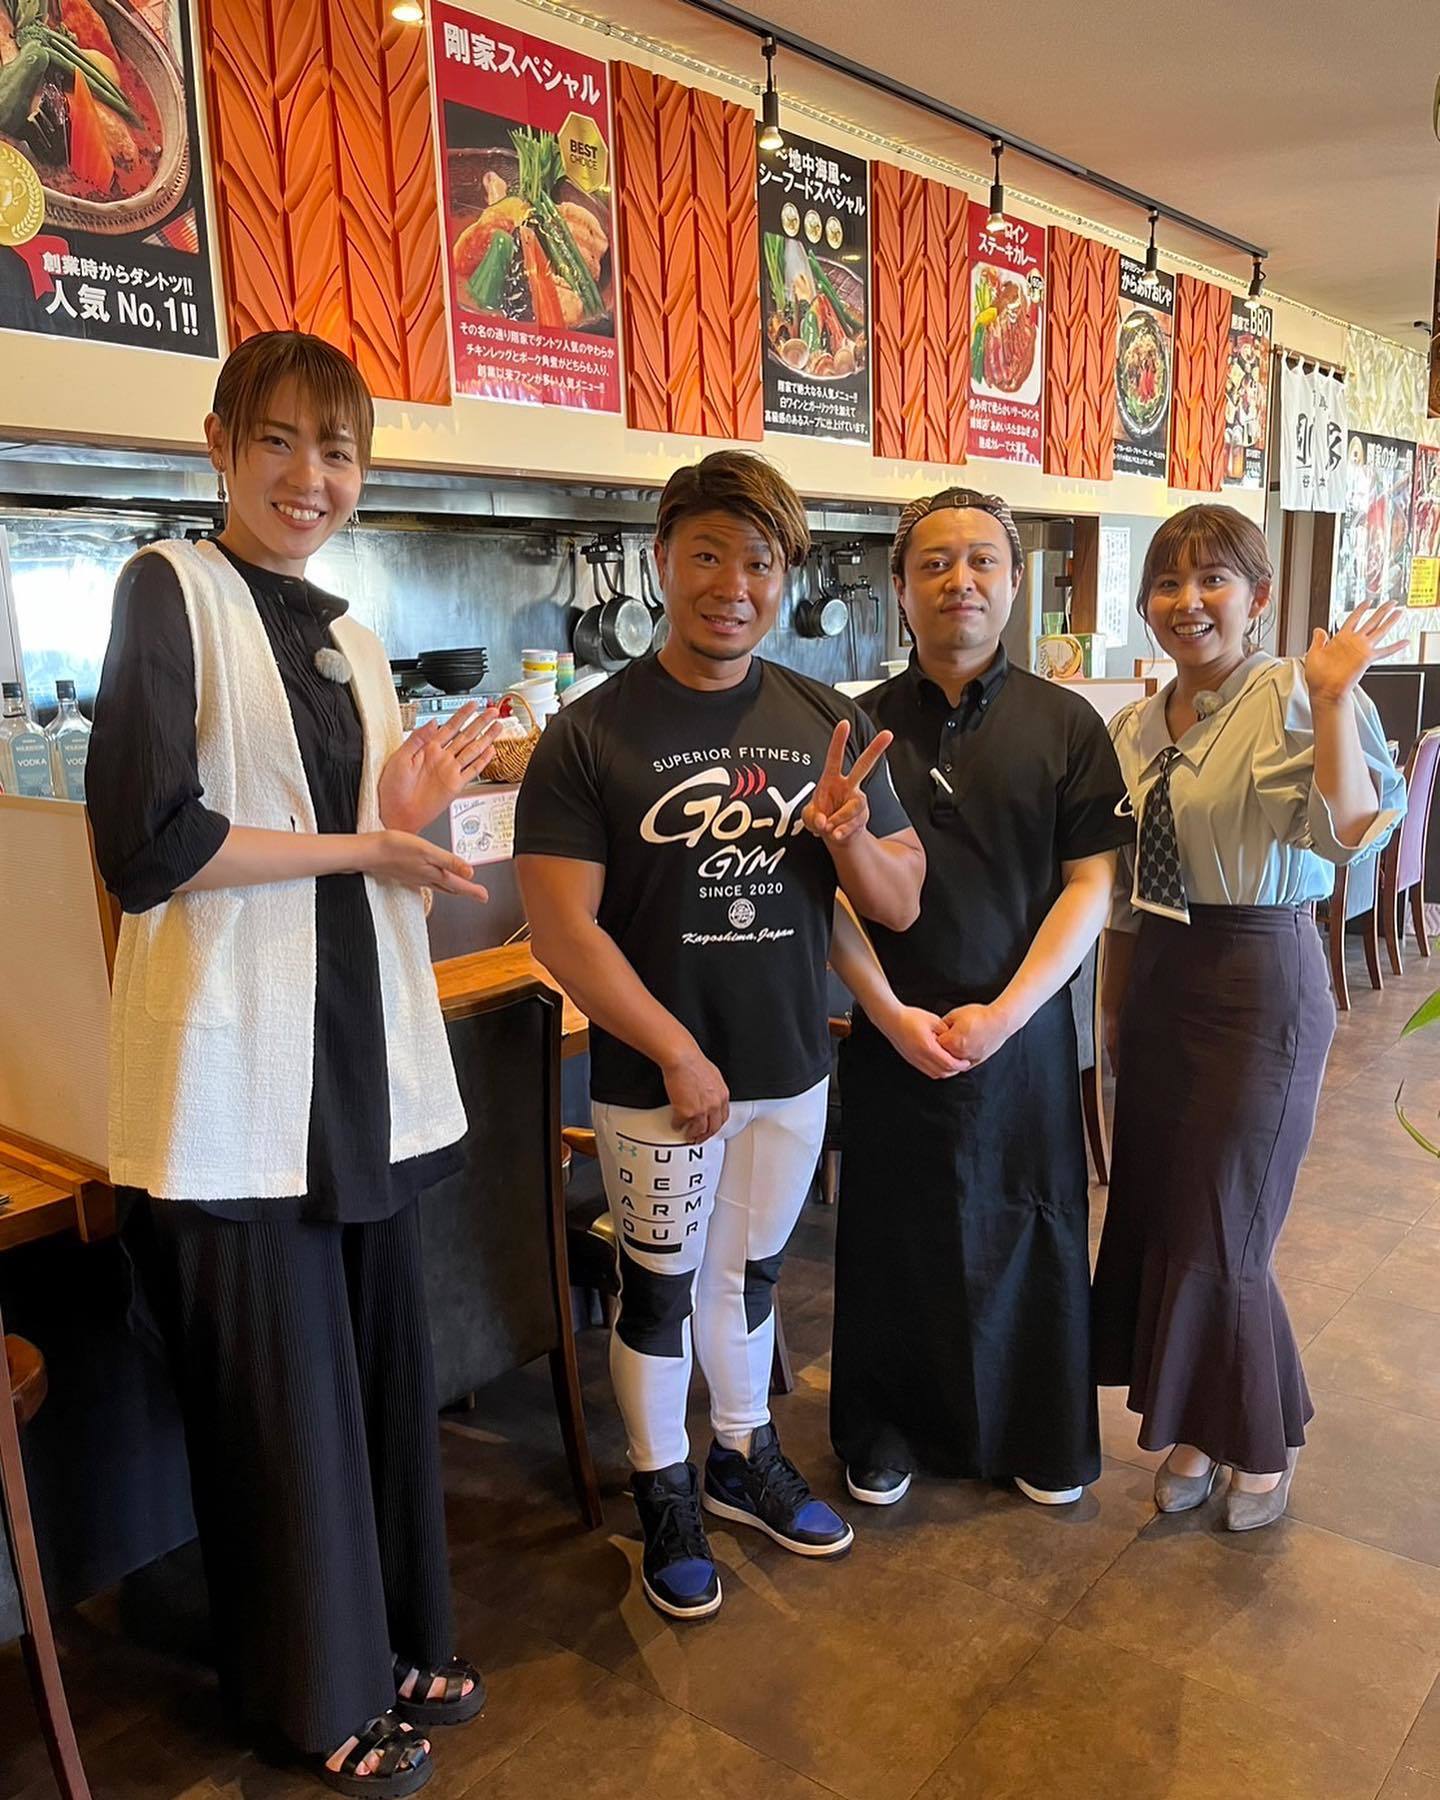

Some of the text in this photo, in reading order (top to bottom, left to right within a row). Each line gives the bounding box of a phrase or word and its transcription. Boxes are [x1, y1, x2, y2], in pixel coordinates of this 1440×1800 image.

[443, 21, 601, 105] 剛家スペシャル
[570, 139, 598, 158] BEST
[570, 155, 598, 171] CHOICE
[758, 162, 866, 217] シーフードスペシャル
[978, 232, 1037, 266] ステーキカレー
[45, 282, 111, 324] 人気
[17, 757, 47, 768] VODKA
[65, 757, 87, 767] VOD
[653, 746, 812, 773] SUPERIOR FITNESS
[697, 844, 786, 880] GYM
[699, 882, 783, 900] SINCE 2020
